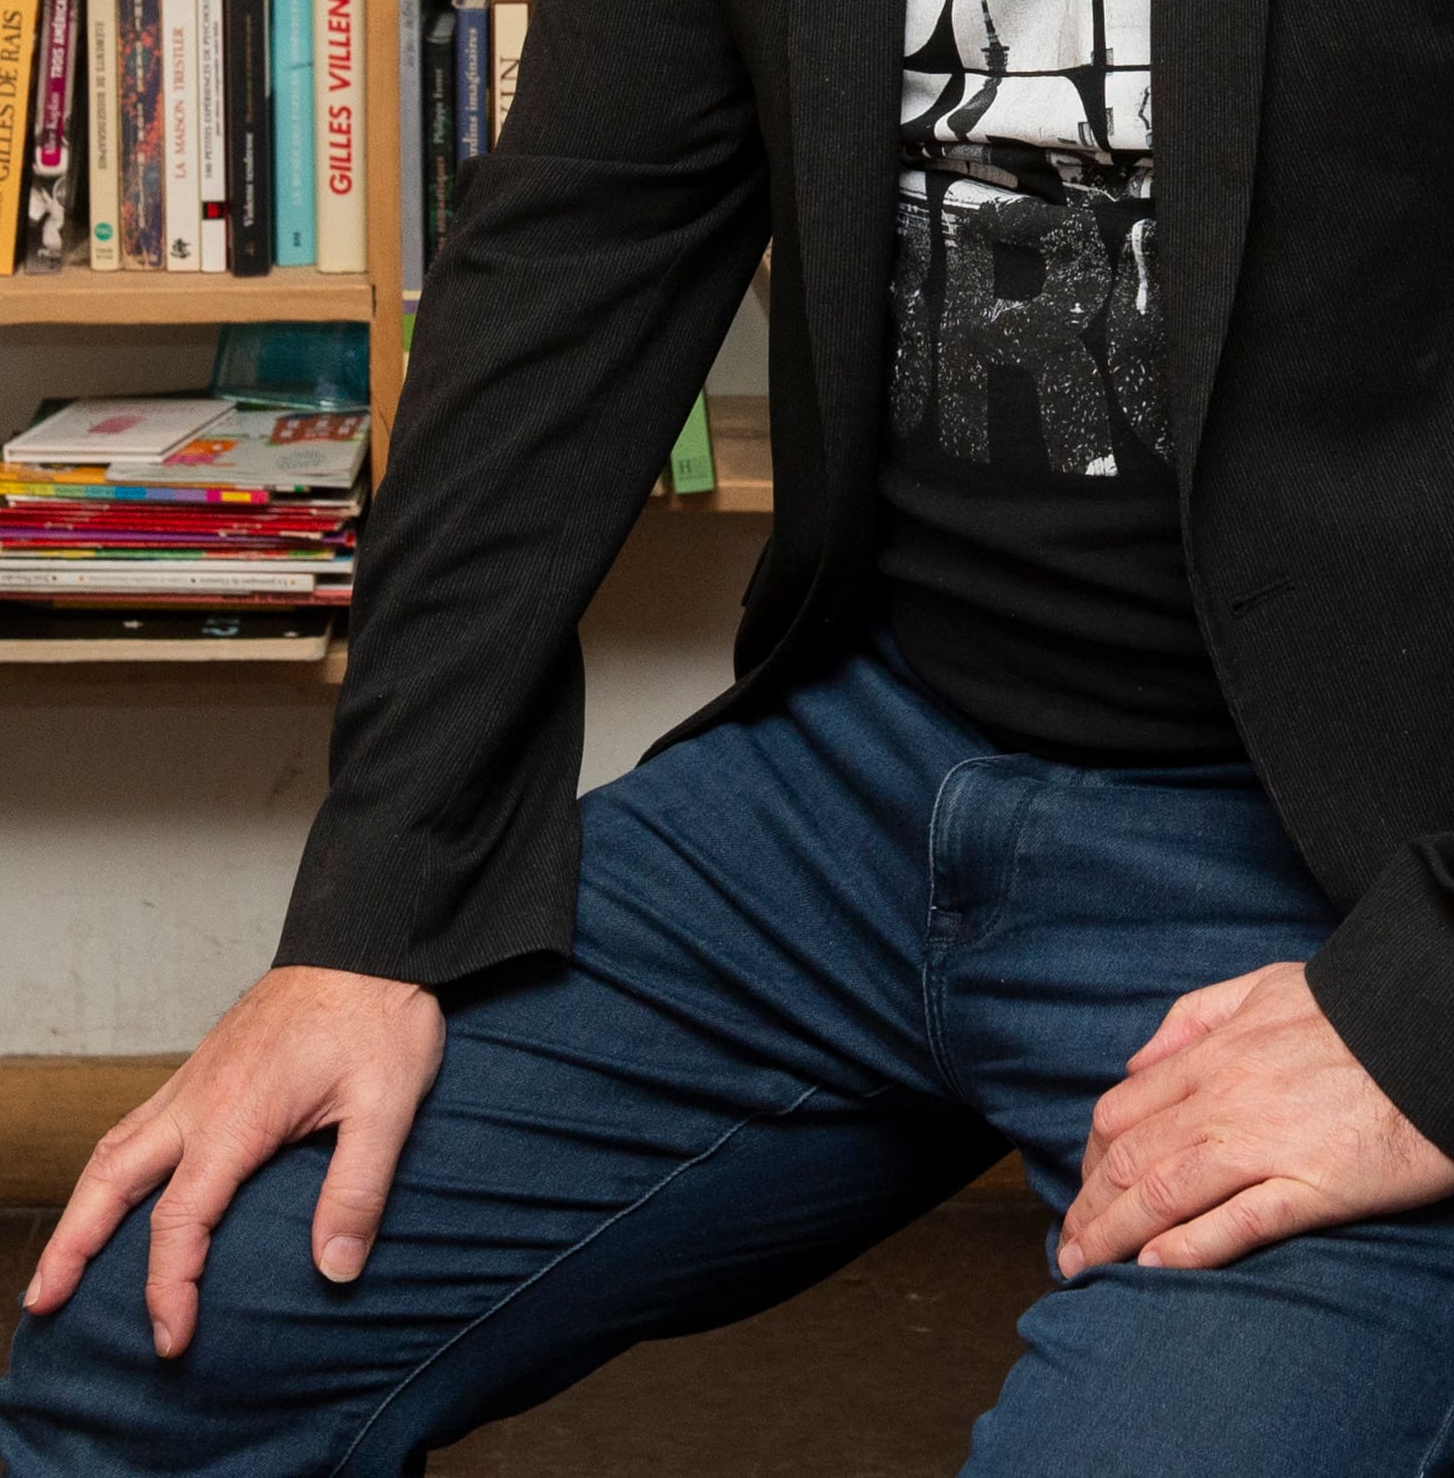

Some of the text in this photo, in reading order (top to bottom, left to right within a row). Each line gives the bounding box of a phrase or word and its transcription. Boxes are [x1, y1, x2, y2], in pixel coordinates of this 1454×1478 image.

[1, 11, 21, 61] RAIS
[172, 27, 186, 179] LA MAISON TRESTLER
[328, 106, 353, 196] GILLES
